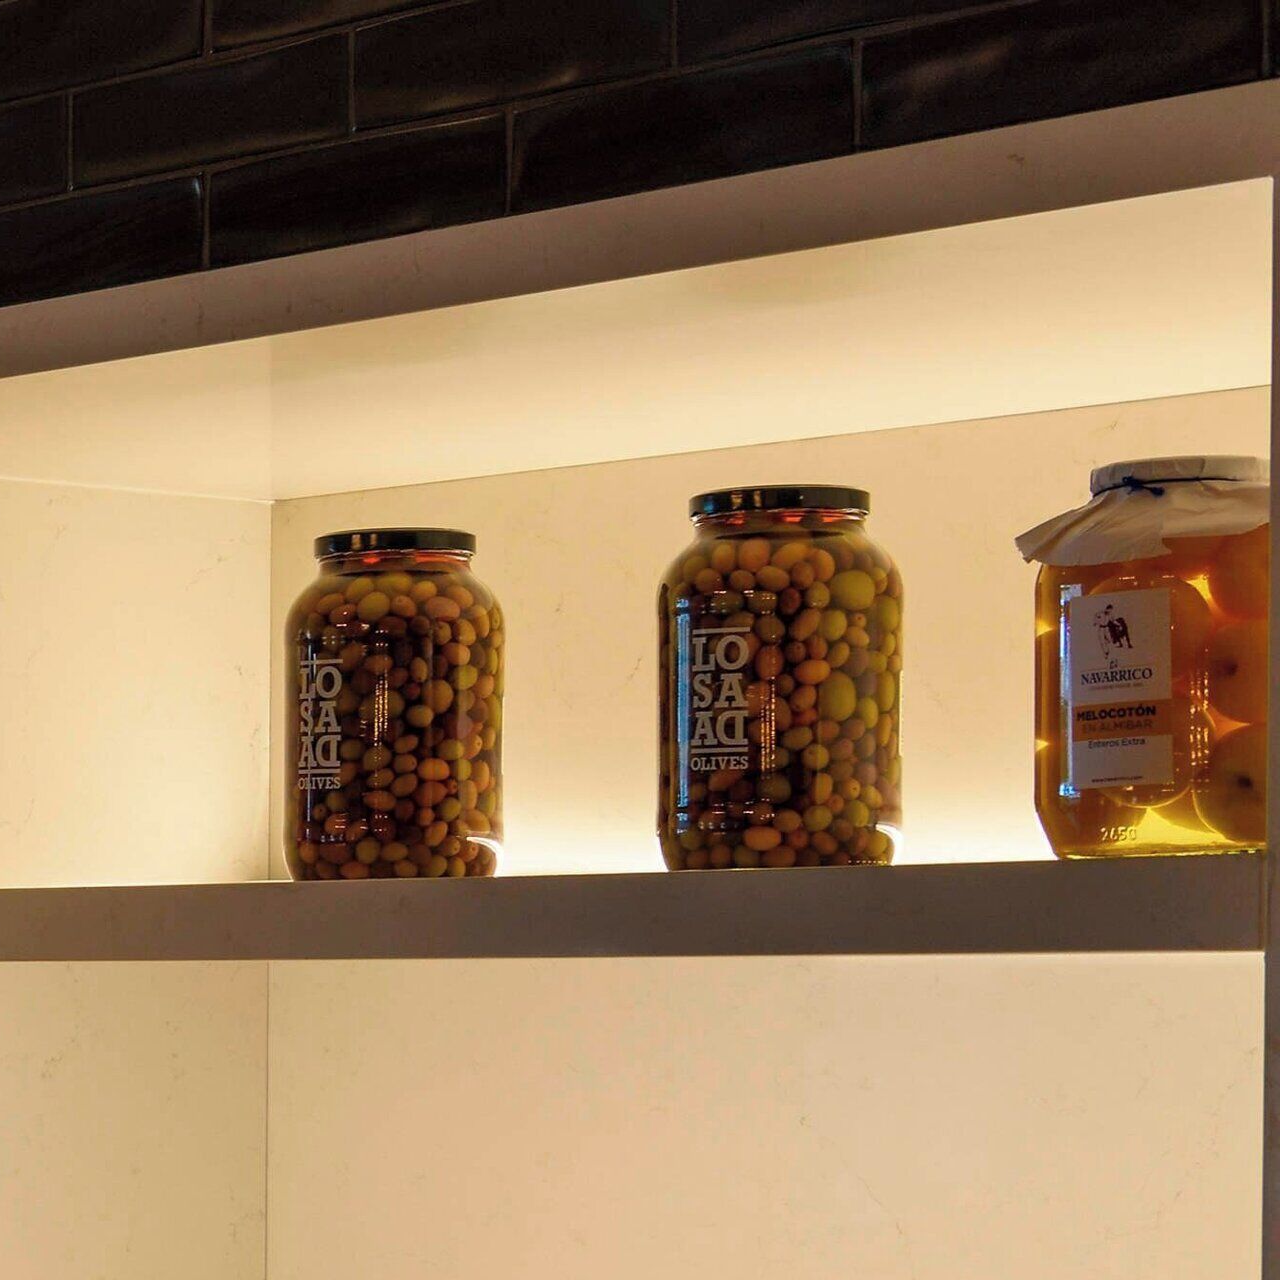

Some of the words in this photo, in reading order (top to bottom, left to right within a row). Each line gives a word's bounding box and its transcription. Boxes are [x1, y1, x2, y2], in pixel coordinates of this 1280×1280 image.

[692, 635, 750, 672] LO
[300, 666, 342, 699] LO
[1081, 668, 1153, 686] NAVARRICO
[693, 672, 749, 709] SA
[300, 701, 341, 733] SA
[1077, 704, 1157, 722] MELOCOTÓN
[691, 756, 749, 771] OLIVES
[298, 777, 341, 790] OLIVES
